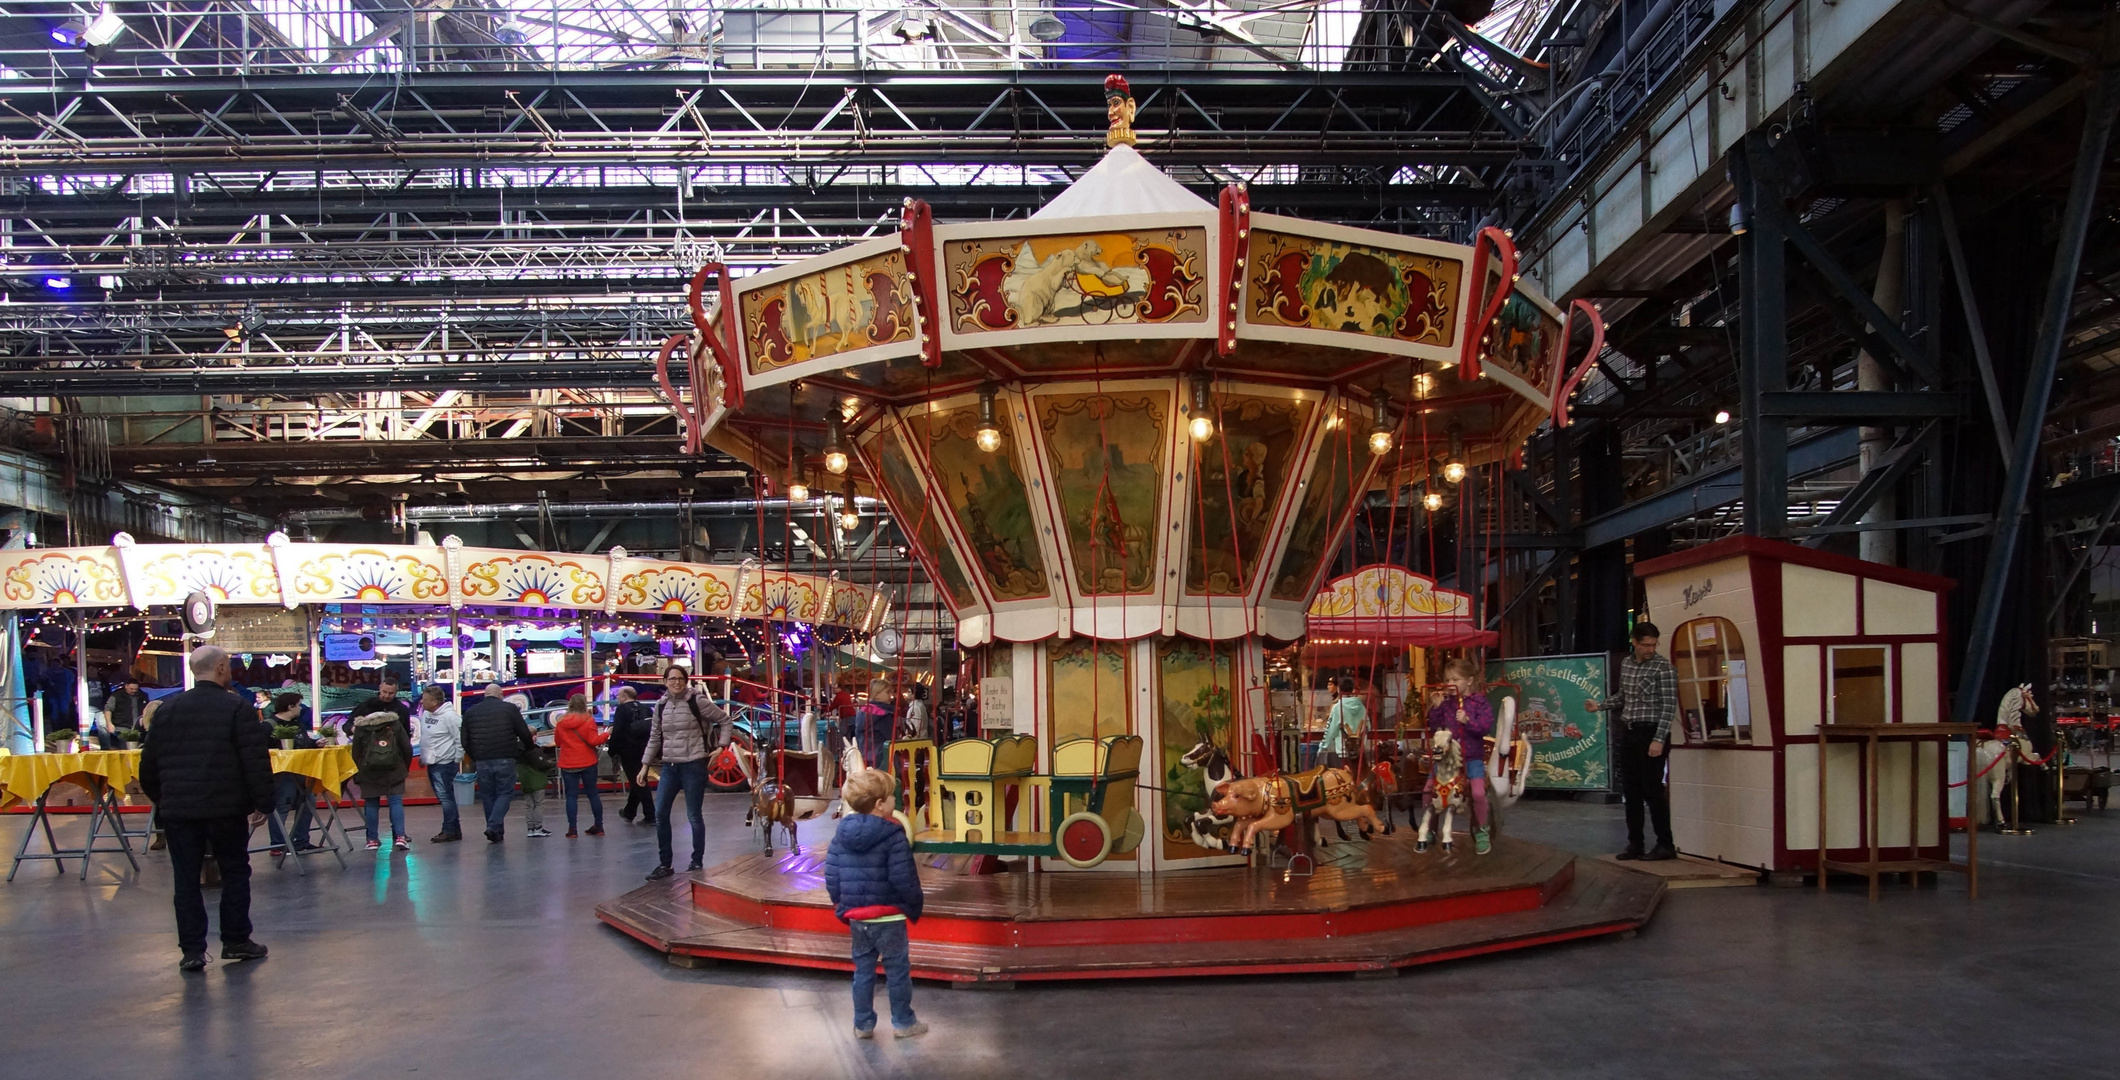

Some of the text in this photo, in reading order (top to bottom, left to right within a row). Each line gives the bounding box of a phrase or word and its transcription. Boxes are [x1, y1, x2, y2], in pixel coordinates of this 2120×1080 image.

[1682, 578, 1713, 610] Kasse
[1535, 664, 1602, 699] Gesellschaft
[1534, 733, 1597, 764] Schausteller
